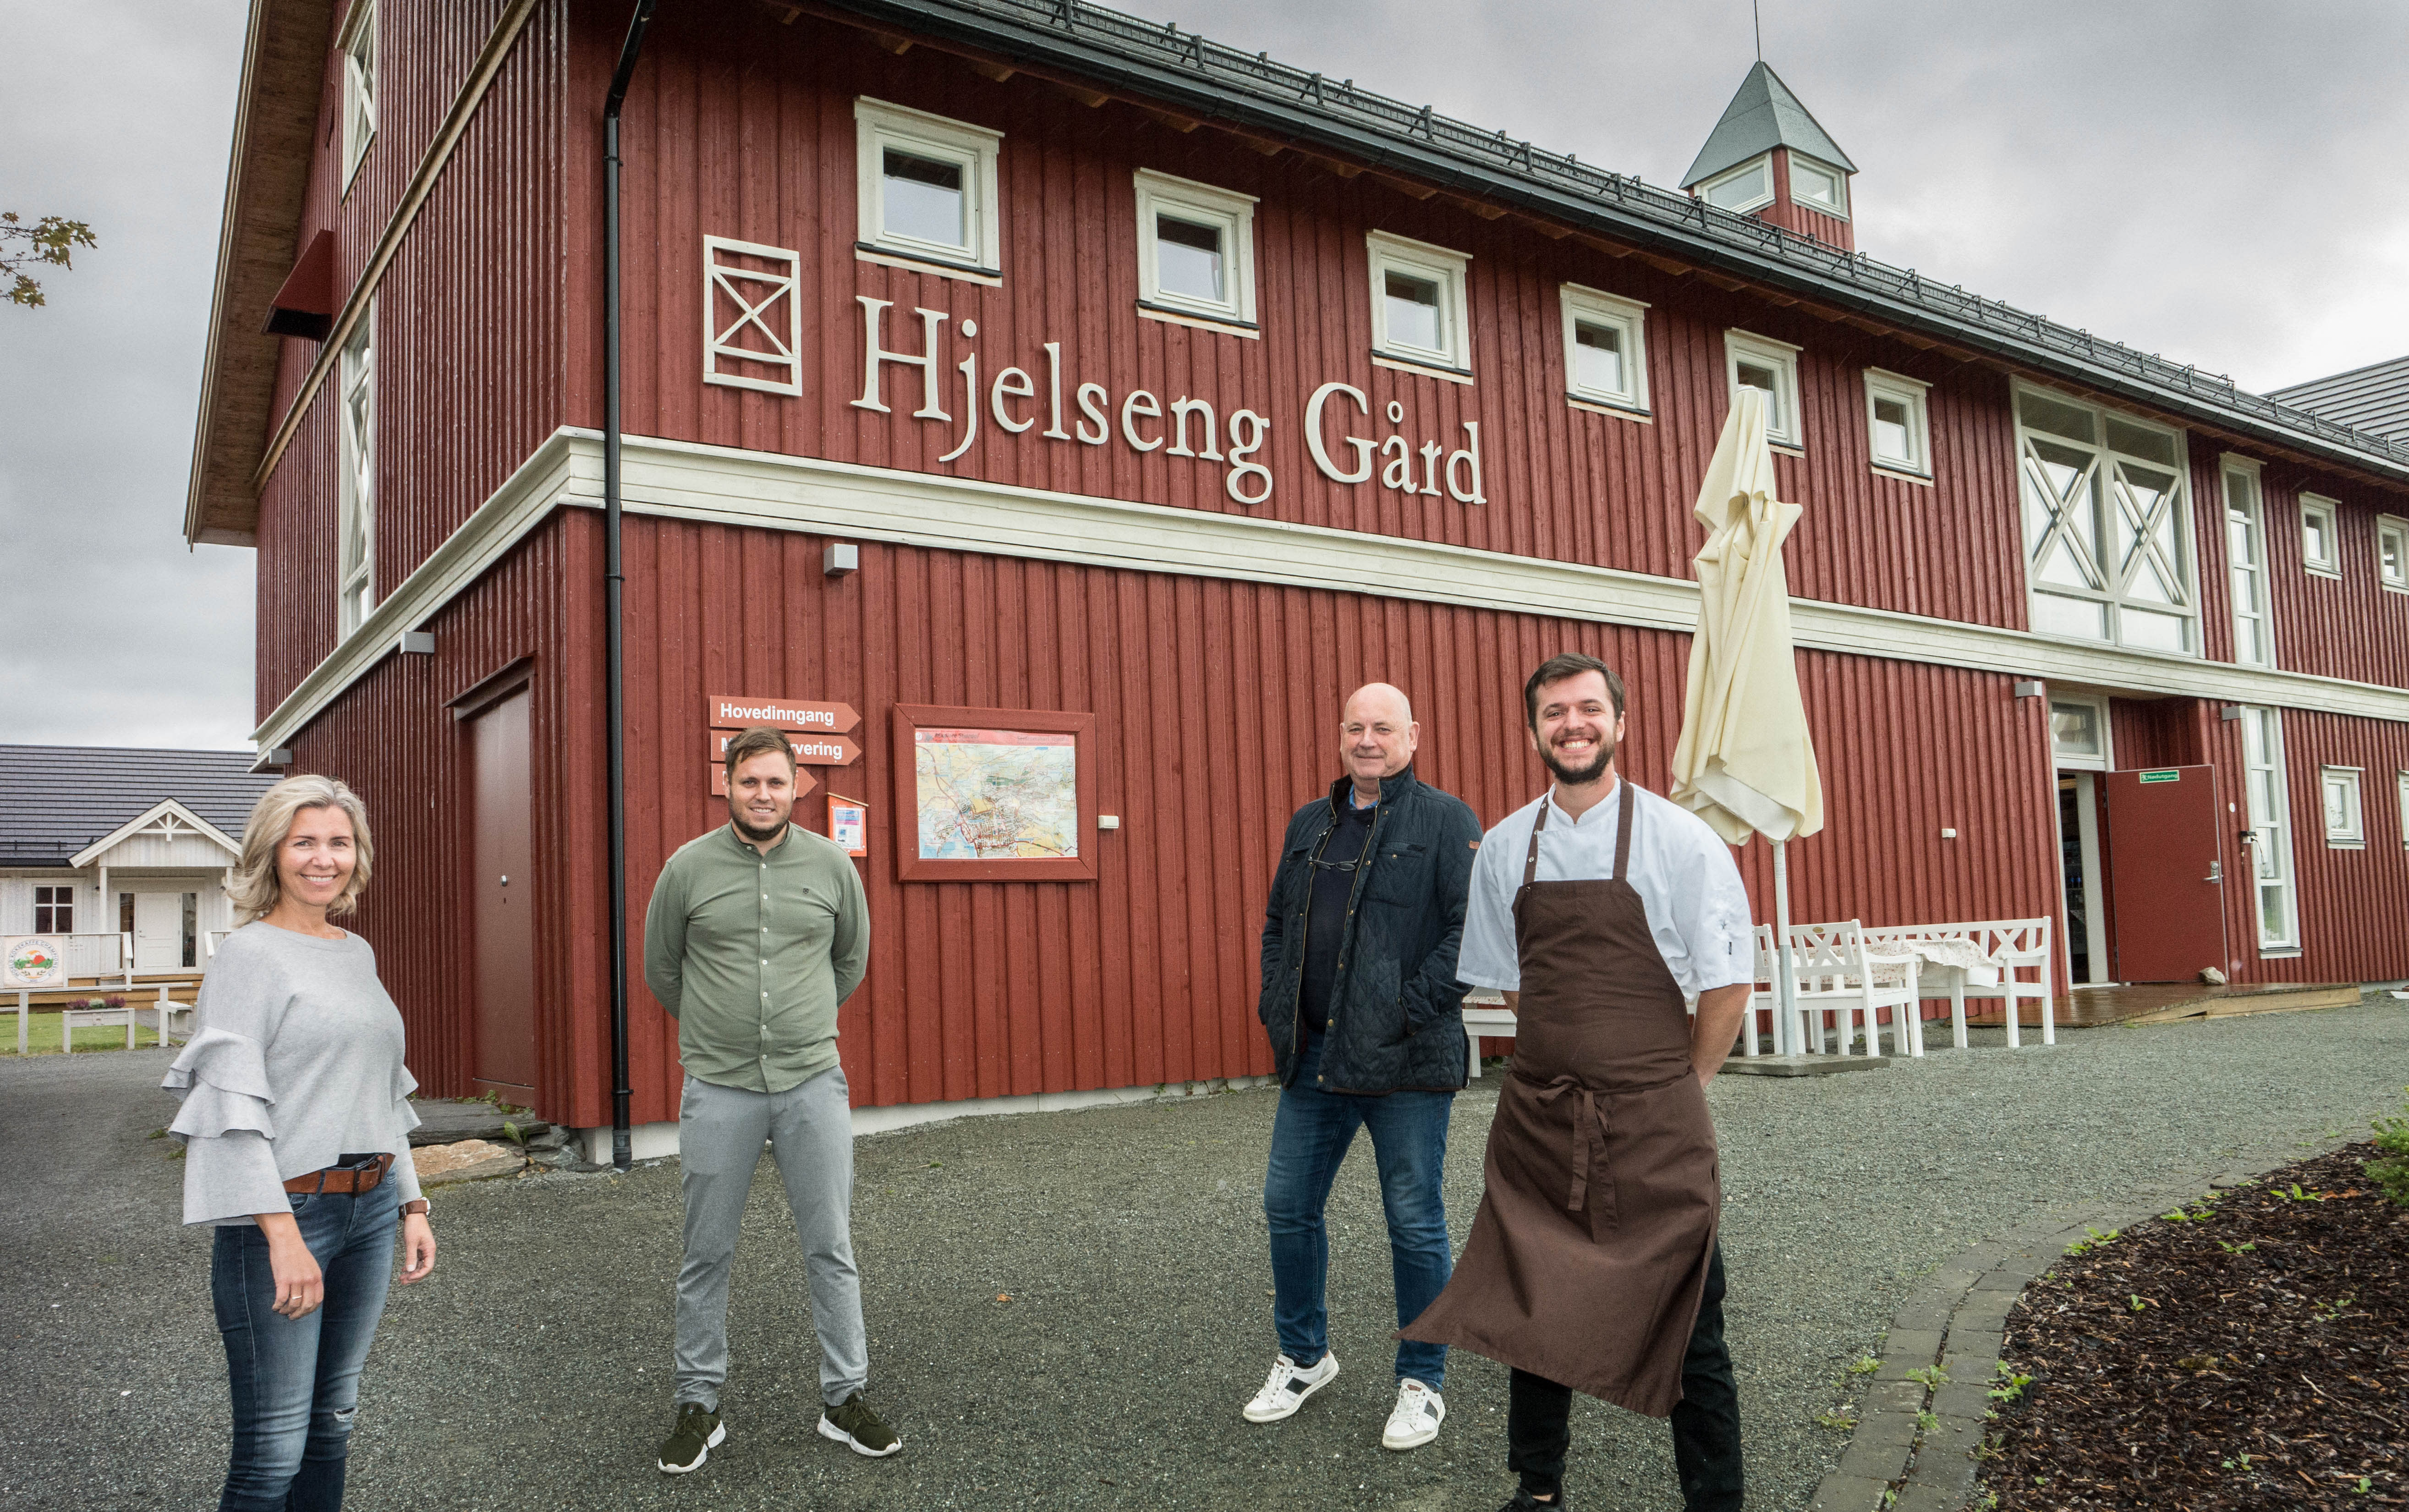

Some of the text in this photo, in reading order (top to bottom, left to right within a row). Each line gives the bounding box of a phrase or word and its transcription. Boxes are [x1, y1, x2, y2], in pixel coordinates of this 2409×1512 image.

[850, 296, 1487, 504] Hjelseng Gård
[720, 703, 834, 726] Hovedinngang
